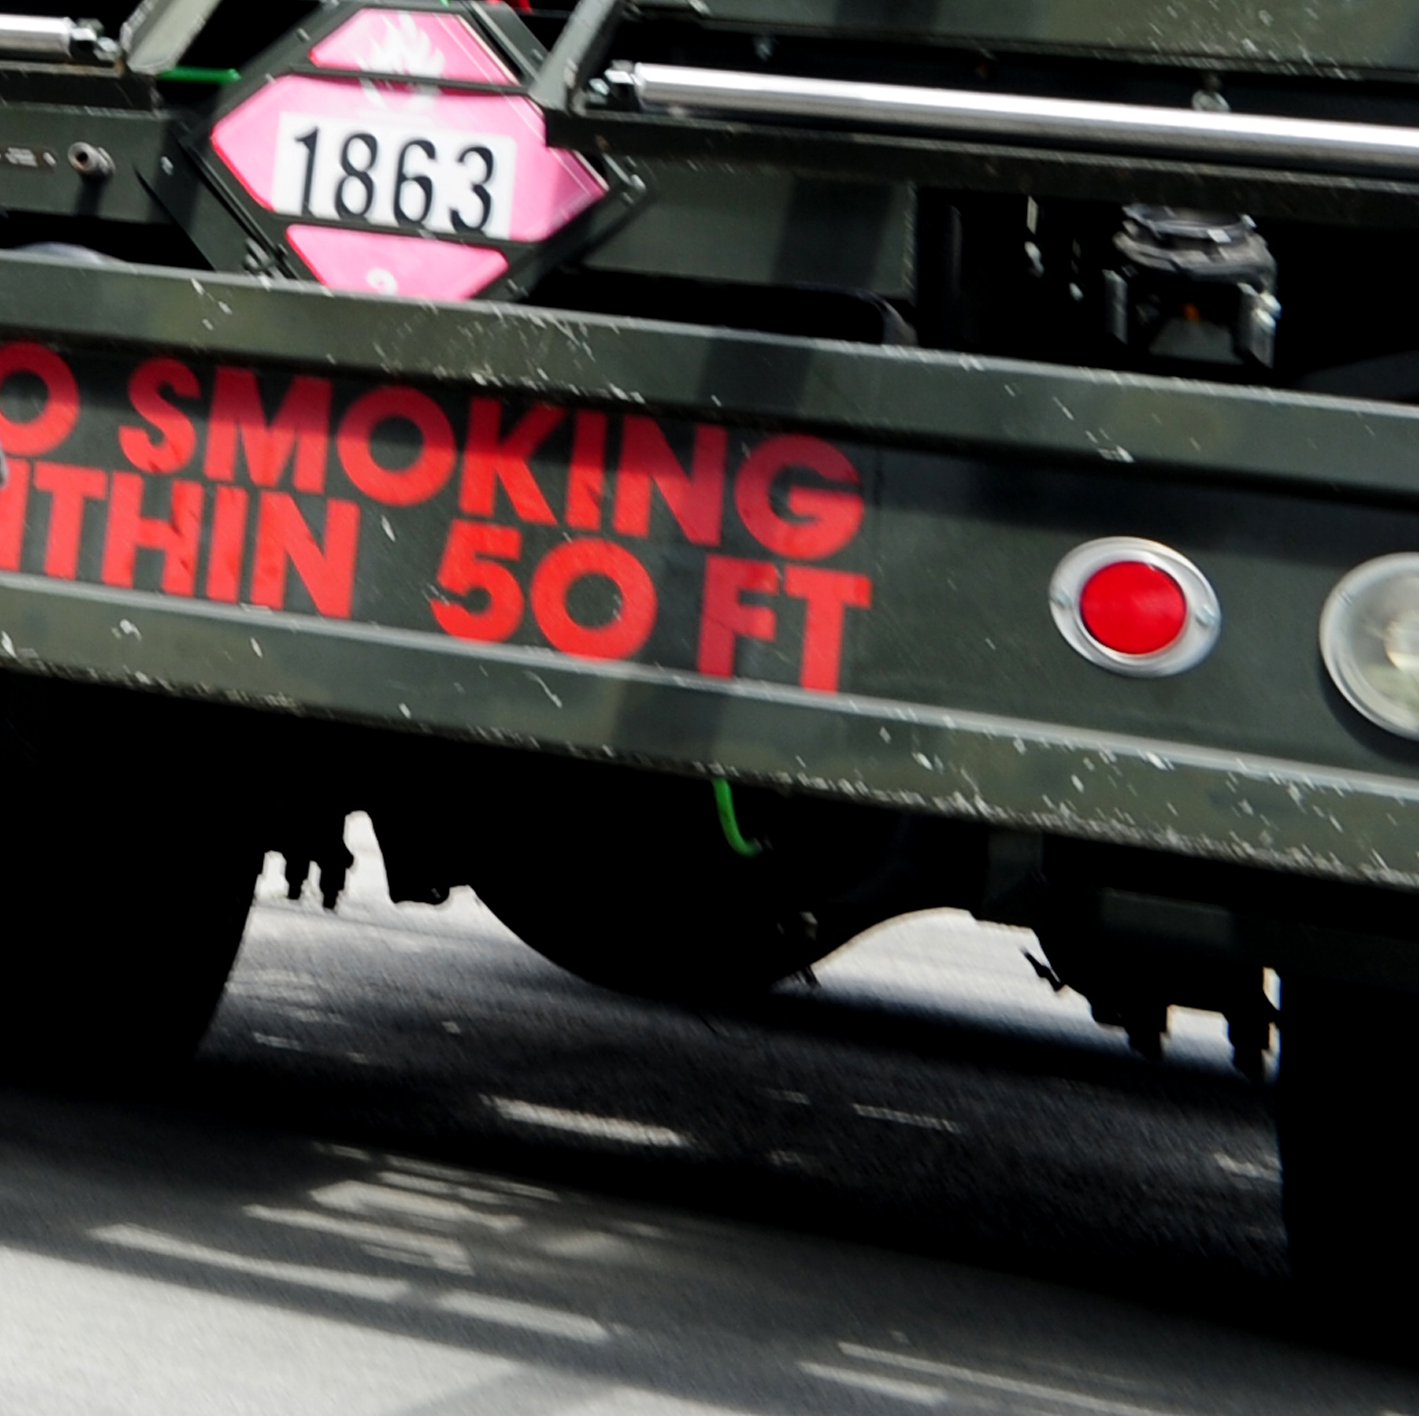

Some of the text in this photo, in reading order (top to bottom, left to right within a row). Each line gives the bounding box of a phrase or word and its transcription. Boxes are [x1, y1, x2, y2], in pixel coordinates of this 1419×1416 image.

[293, 125, 495, 234] 1863
[117, 358, 866, 561] SMOKING
[429, 518, 658, 664] 50
[696, 554, 873, 695] FT
